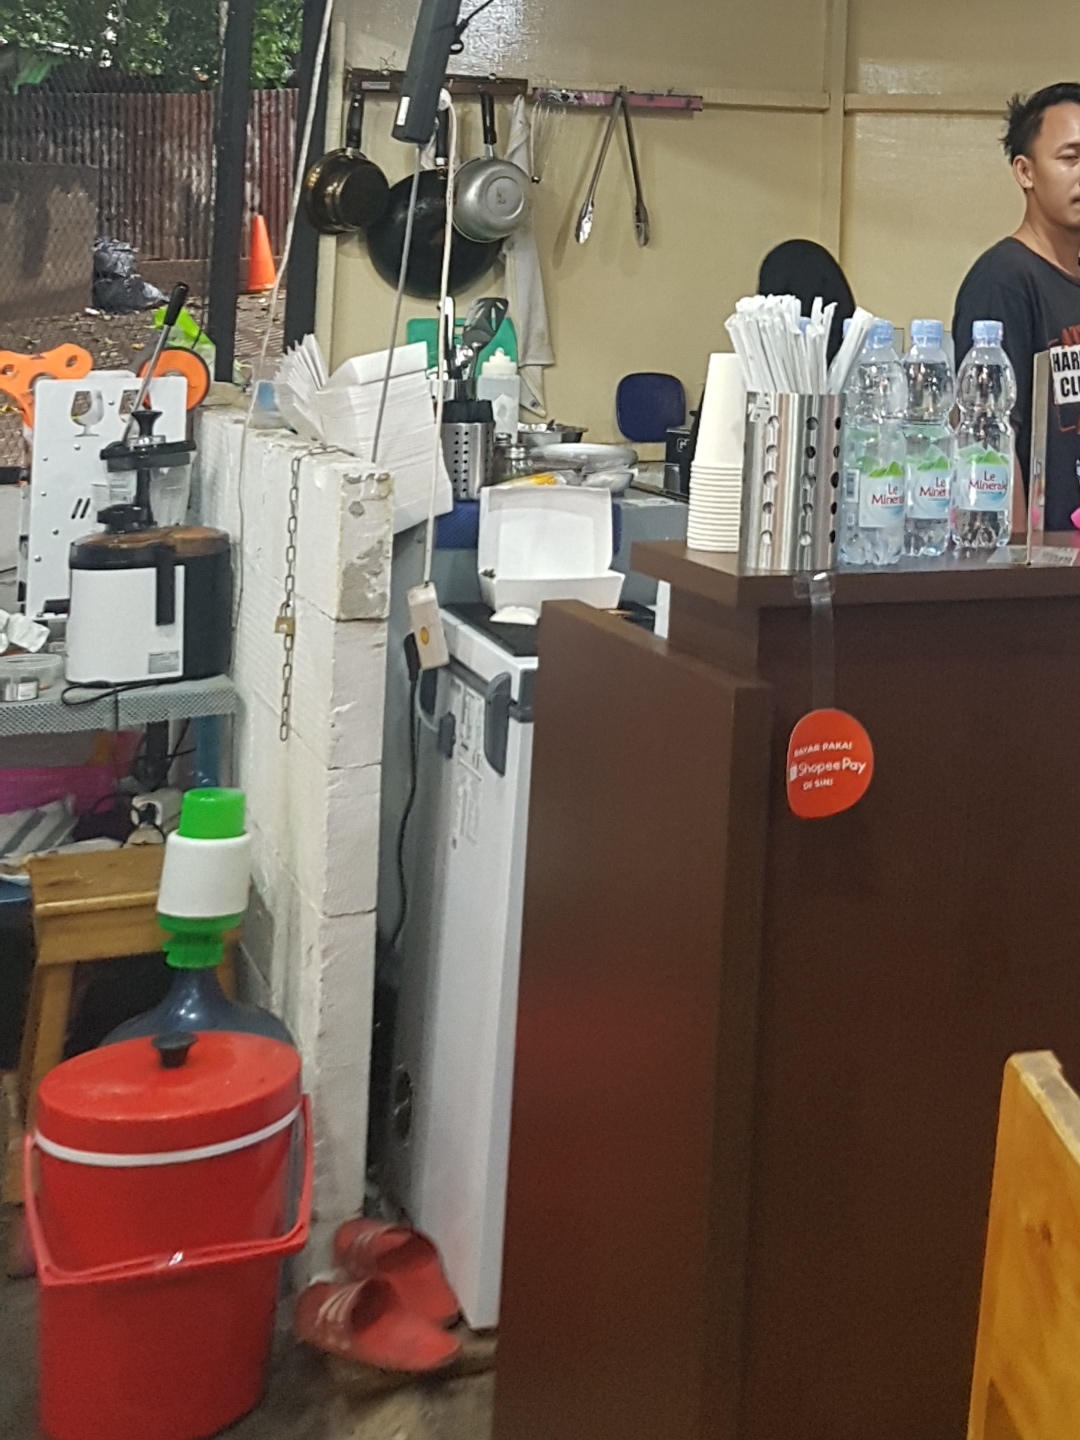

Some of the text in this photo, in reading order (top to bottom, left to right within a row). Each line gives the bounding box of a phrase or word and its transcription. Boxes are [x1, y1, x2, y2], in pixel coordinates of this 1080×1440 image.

[935, 476, 946, 488] Le
[984, 471, 996, 482] Le
[887, 483, 899, 495] Le
[822, 741, 853, 752] PAKAI
